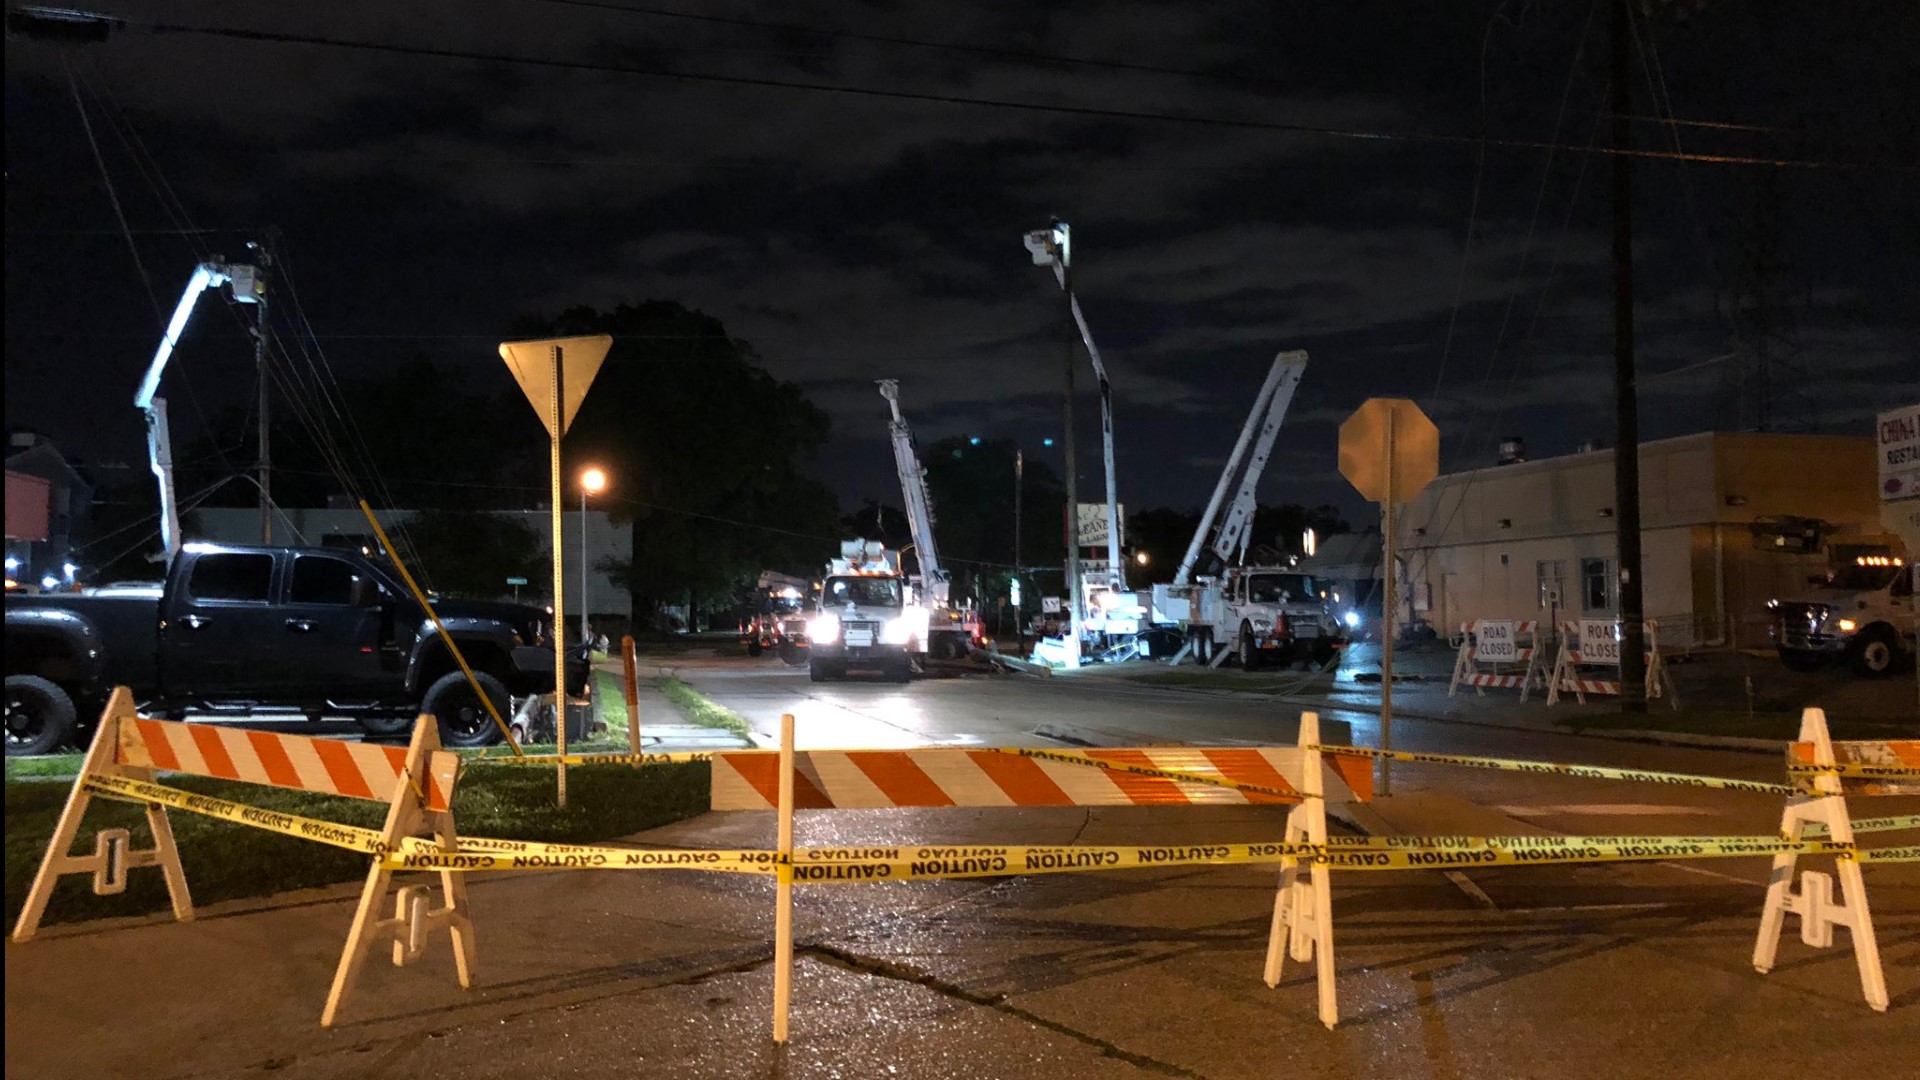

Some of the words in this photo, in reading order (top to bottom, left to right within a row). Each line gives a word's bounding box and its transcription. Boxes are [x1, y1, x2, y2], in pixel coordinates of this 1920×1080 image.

[1483, 625, 1507, 639] ROAD
[1480, 642, 1512, 655] CLOSED
[186, 794, 236, 817] CAUTION
[241, 807, 294, 831] CAUTION
[301, 821, 357, 845] CAUTION
[403, 854, 496, 868] CAUTION
[513, 854, 608, 868] CAUTION
[625, 852, 722, 865] CAUTION
[793, 863, 892, 880] CAUTION
[910, 856, 1008, 877] CAUTION
[1026, 850, 1120, 870] CAUTION
[1138, 846, 1231, 864] CAUTION
[1407, 849, 1498, 866] CAUTION
[1513, 846, 1601, 862] CAUTION
